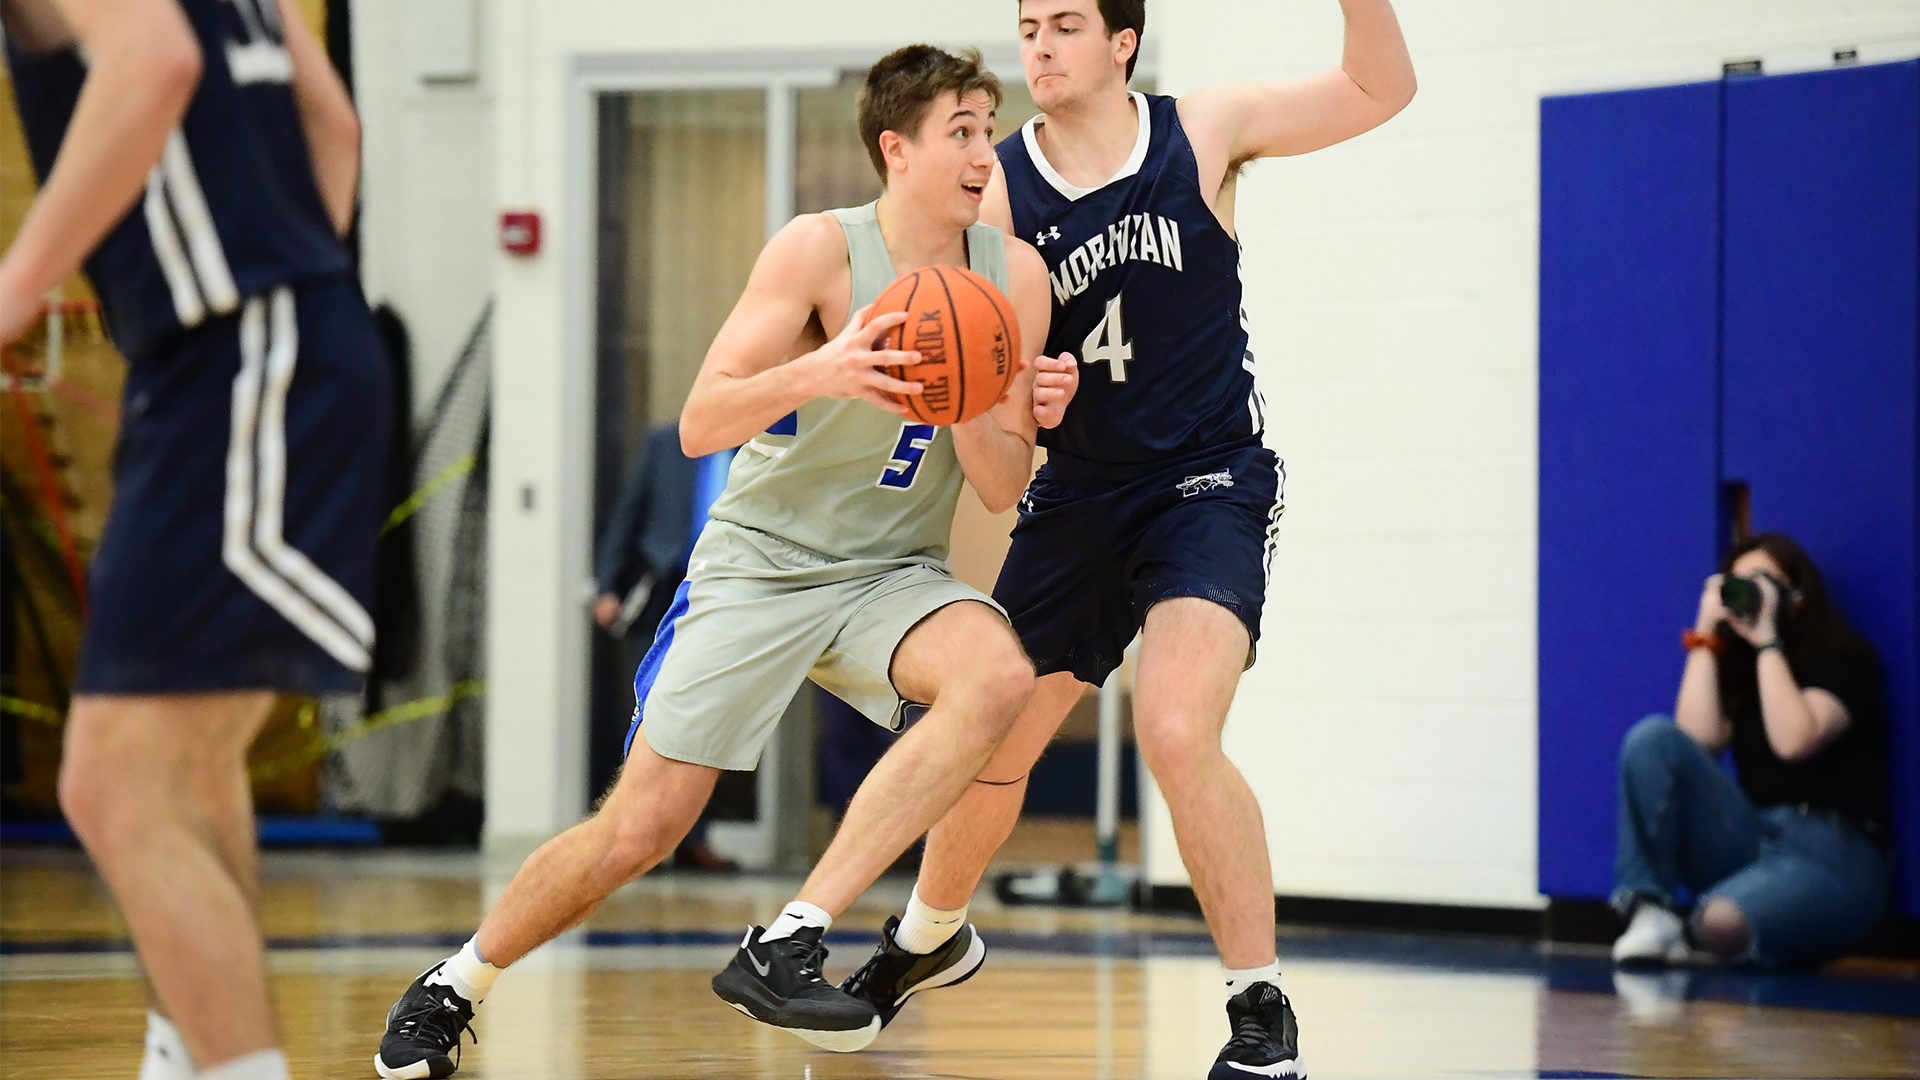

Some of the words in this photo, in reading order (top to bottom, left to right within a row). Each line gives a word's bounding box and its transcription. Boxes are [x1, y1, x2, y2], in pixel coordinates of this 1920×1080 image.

[914, 309, 946, 367] ROCK
[1080, 290, 1134, 384] 4
[916, 376, 950, 413] THE
[876, 421, 939, 491] 5
